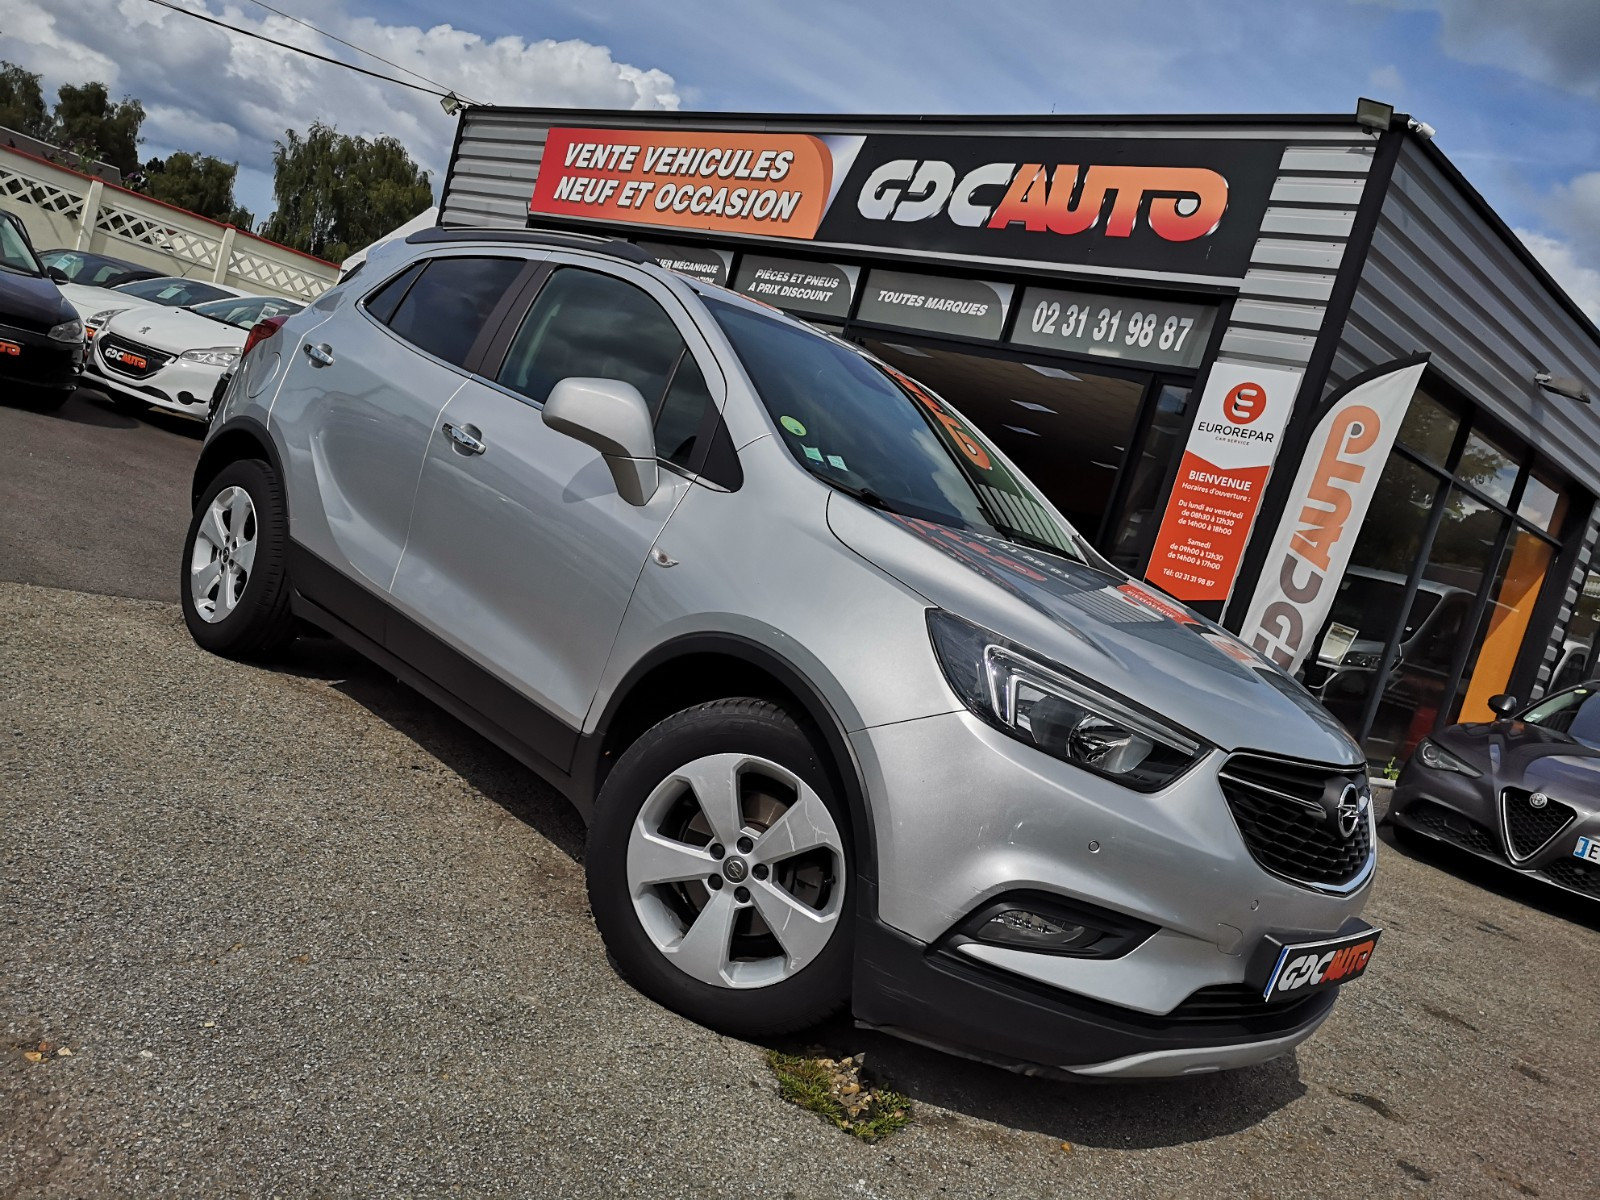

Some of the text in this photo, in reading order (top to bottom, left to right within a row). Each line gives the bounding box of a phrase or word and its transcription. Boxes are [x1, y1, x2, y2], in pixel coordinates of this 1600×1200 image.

[563, 142, 795, 181] VENTE VEHICULES
[552, 176, 803, 222] NEUF ET OCCASION
[755, 267, 840, 289] PIÈCES ET PNEUS
[748, 281, 834, 302] A PRIX DISCOUNT
[877, 290, 989, 316] TOUTES MARQUES
[1031, 300, 1195, 352] 02 31 31 98 87
[1198, 421, 1275, 443] EUROREPAR
[1227, 438, 1250, 446] SERVICE
[1181, 482, 1209, 494] Horaires
[1188, 470, 1252, 491] BIENVENUE
[1178, 499, 1188, 507] Du
[1188, 501, 1205, 510] lundi
[1214, 508, 1244, 519] vendredi
[1181, 509, 1235, 527] de 08h30 à 12h30
[1187, 519, 1207, 530] 14h00
[1212, 525, 1232, 536] 18h00
[1170, 543, 1178, 551] de
[1179, 545, 1200, 556] 09h00
[1205, 551, 1224, 562] 12h30
[1187, 538, 1211, 549] Samedi
[1167, 551, 1176, 559] de
[1176, 553, 1196, 564] 14h00
[1201, 560, 1221, 570] 17h00
[1174, 571, 1183, 579] 02
[1183, 573, 1190, 581] 31
[1197, 577, 1206, 585] 98
[1278, 940, 1375, 991] GDCAUTO
